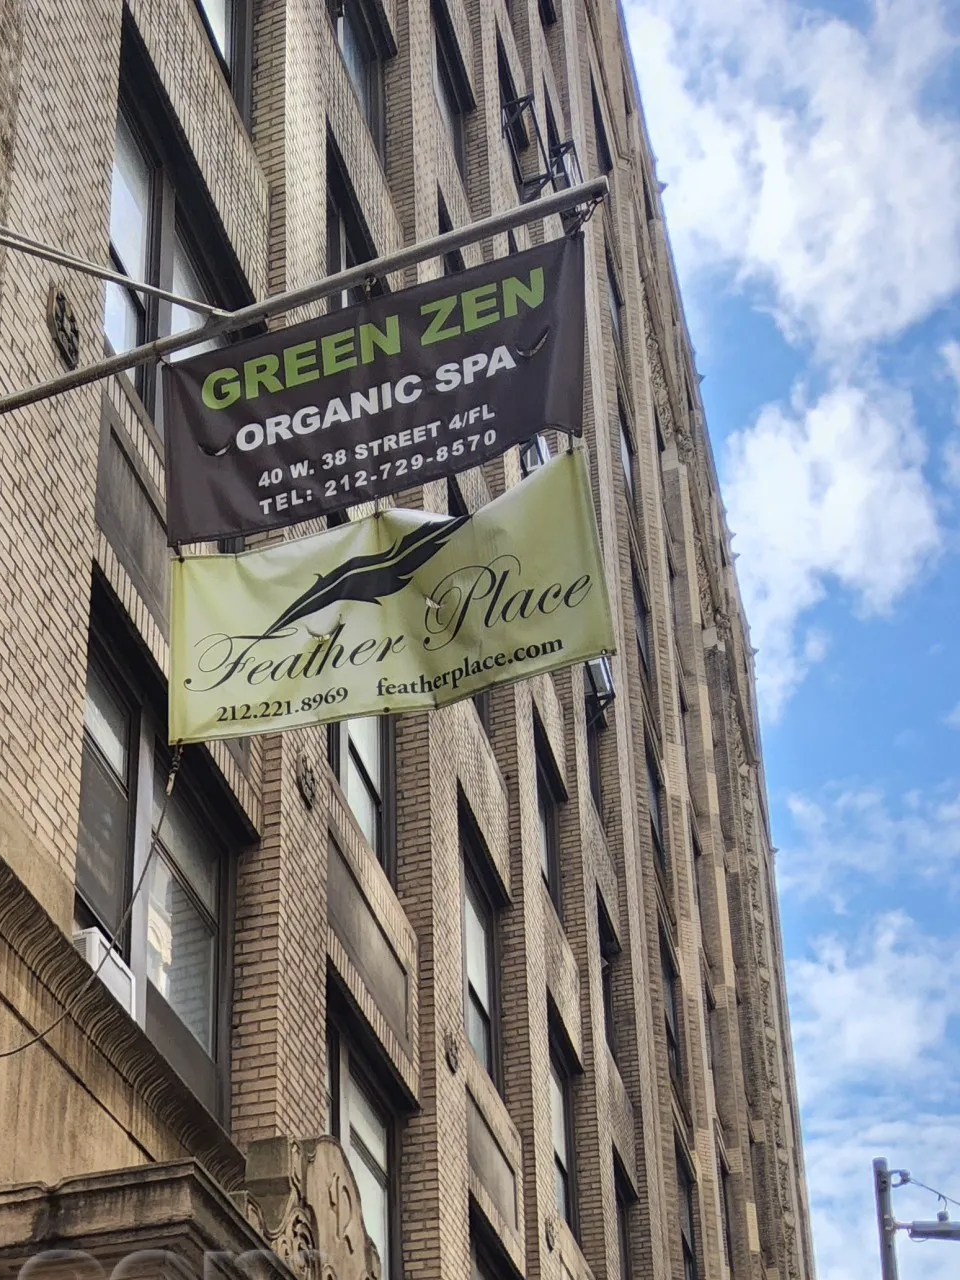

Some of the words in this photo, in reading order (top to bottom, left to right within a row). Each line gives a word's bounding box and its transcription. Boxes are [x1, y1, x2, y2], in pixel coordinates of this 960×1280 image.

[202, 315, 401, 410] GREEN
[420, 268, 544, 347] ZEN
[235, 374, 423, 452] ORGANIC
[435, 345, 517, 393] SPA
[258, 469, 283, 488] 40
[289, 460, 314, 480] W.
[322, 450, 347, 470] 38
[355, 421, 441, 461] STREET
[448, 404, 495, 433] 4/FL
[259, 488, 313, 515] TEL:
[324, 429, 497, 499] 212-729-8570
[183, 616, 406, 692] Feather
[423, 554, 592, 651] Place
[216, 686, 349, 723] 212.221.8969
[375, 636, 563, 697] featherplace.com
